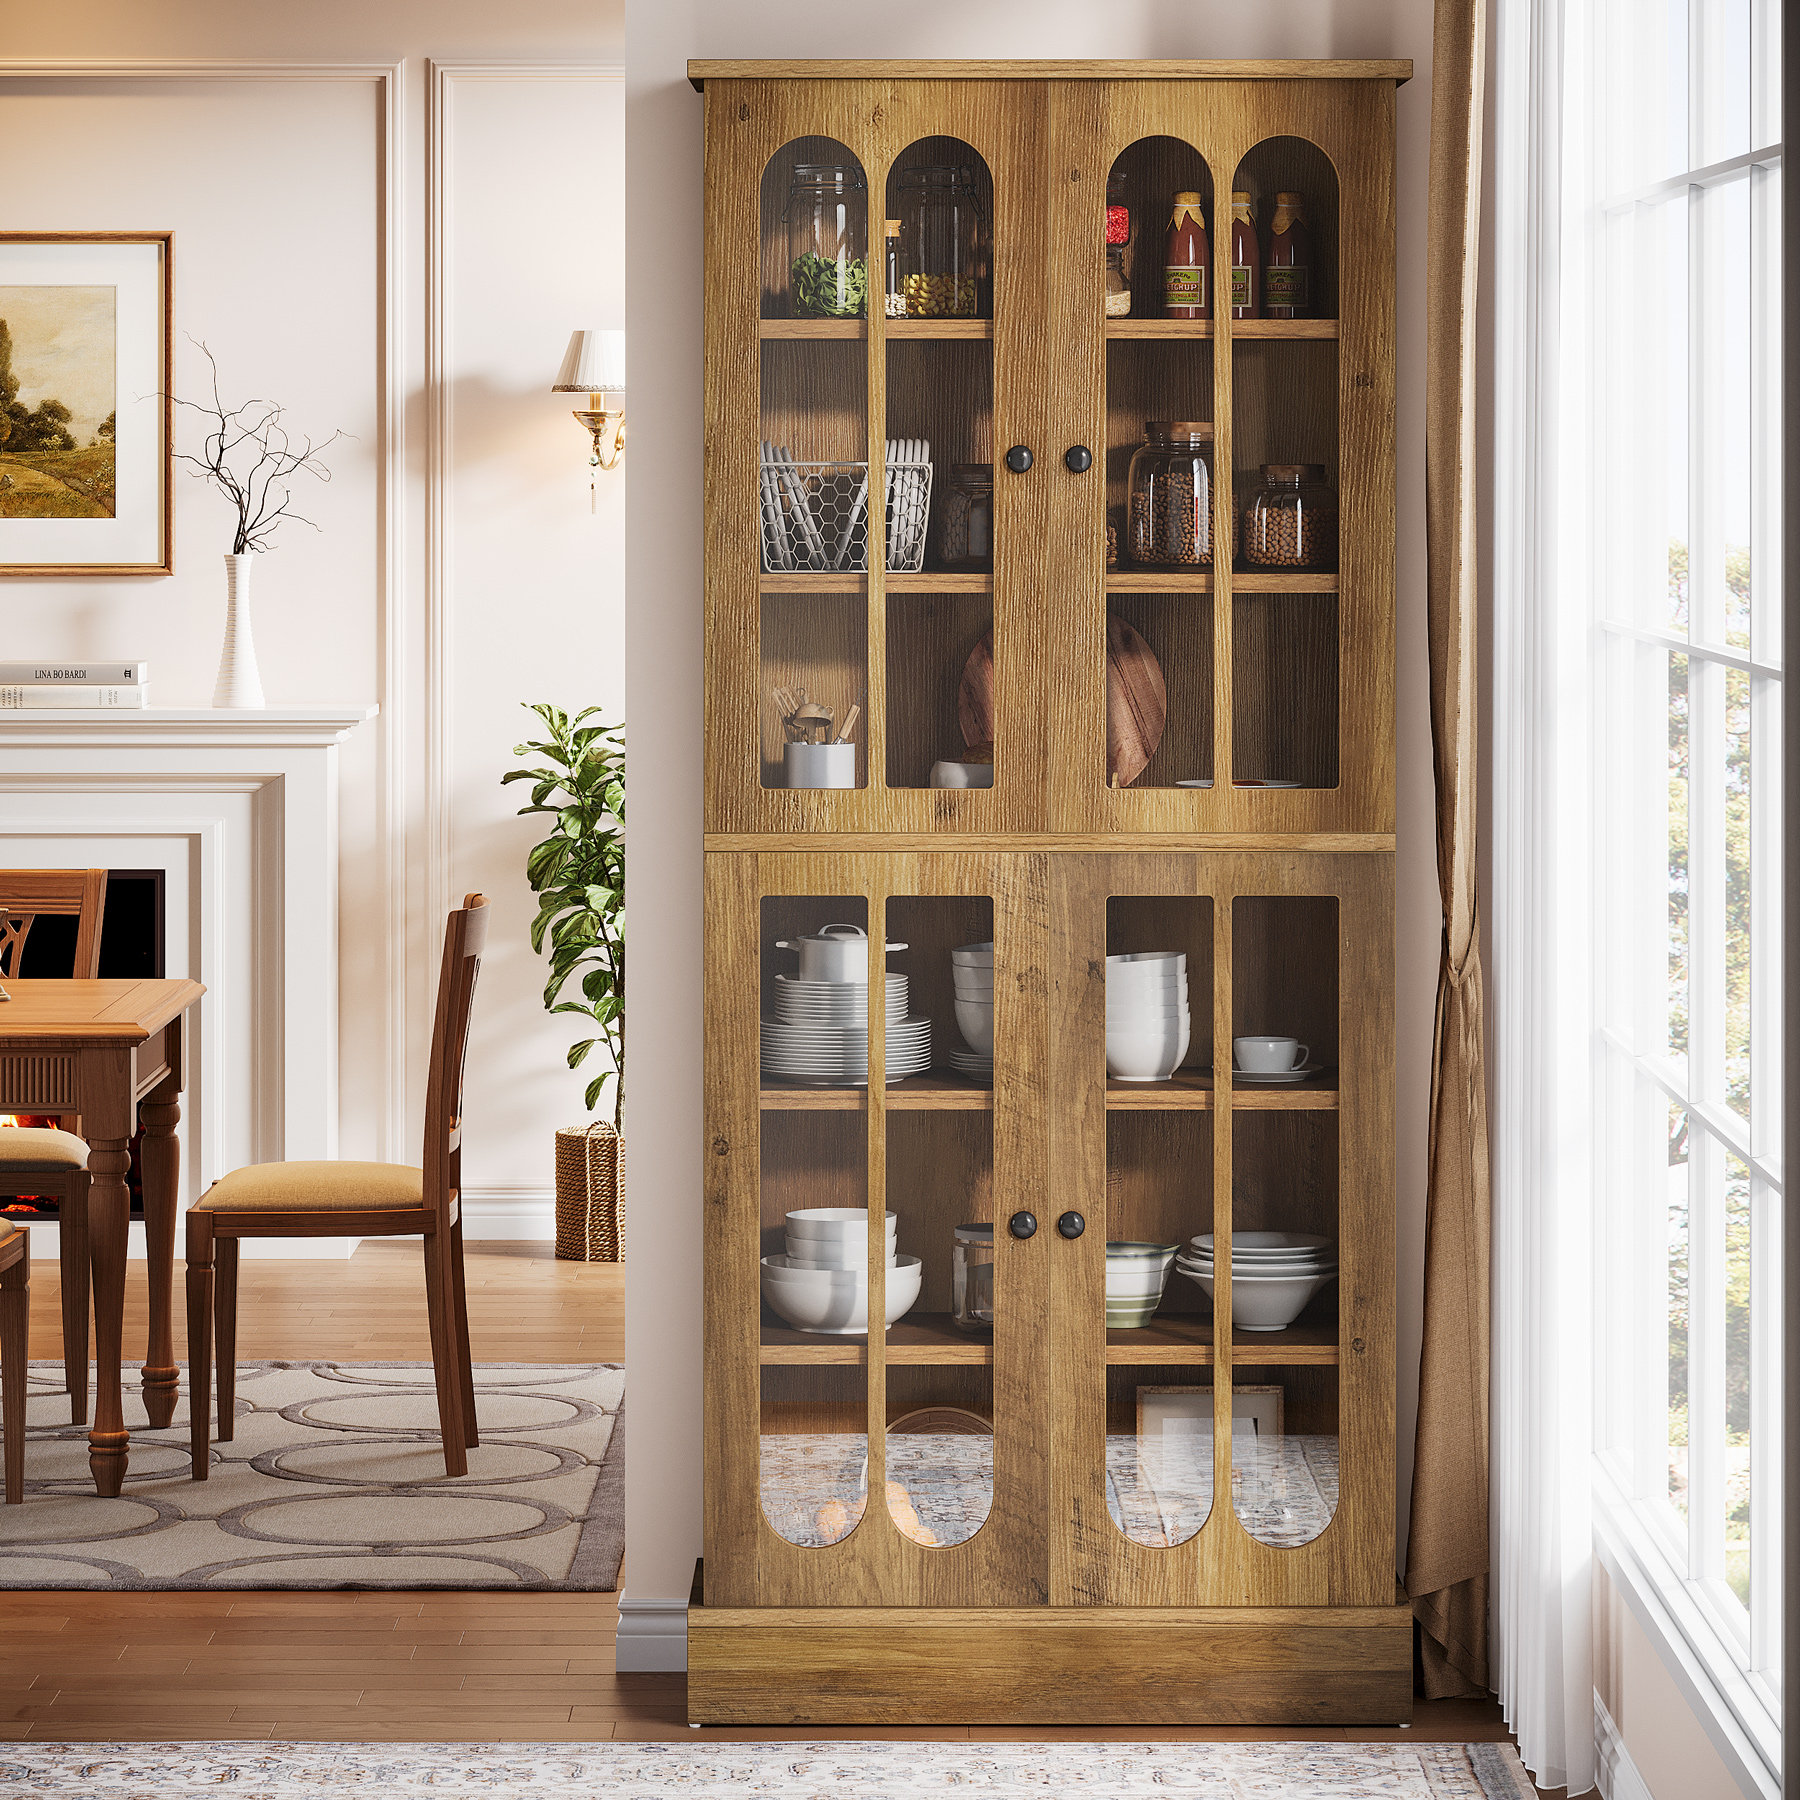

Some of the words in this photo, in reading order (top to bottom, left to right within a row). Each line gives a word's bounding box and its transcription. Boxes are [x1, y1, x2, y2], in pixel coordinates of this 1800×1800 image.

[35, 670, 52, 679] LINA
[53, 669, 63, 679] BO
[64, 670, 87, 679] BARDI
